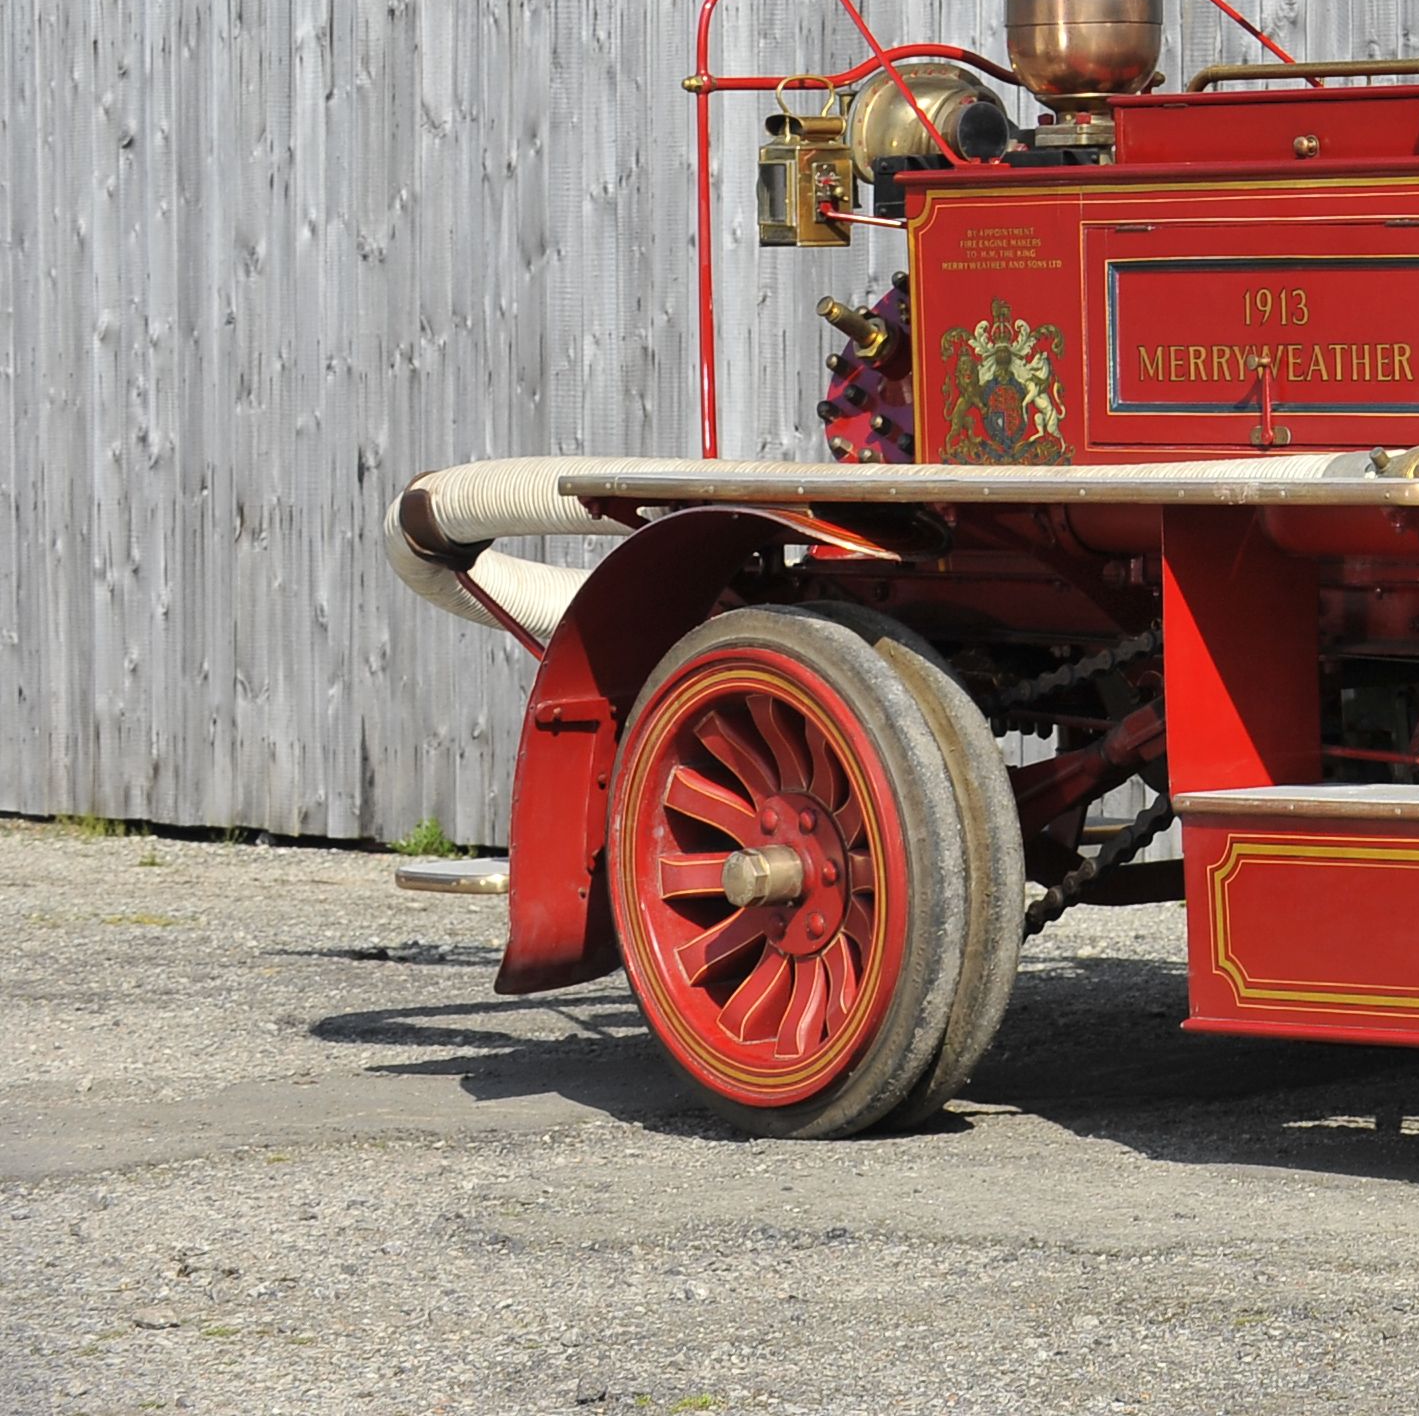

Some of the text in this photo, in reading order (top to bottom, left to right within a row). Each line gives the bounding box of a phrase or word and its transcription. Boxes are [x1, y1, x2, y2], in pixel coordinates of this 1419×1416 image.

[979, 227, 1035, 237] APPOINTMENT
[960, 238, 1042, 248] FIRE ENGINE MAKERS
[966, 250, 977, 258] TO
[1017, 249, 1036, 257] KING
[942, 260, 1006, 271] MERRYWEATHER
[1008, 261, 1025, 269] AND
[1027, 260, 1047, 269] SONS
[1243, 287, 1310, 326] 1913
